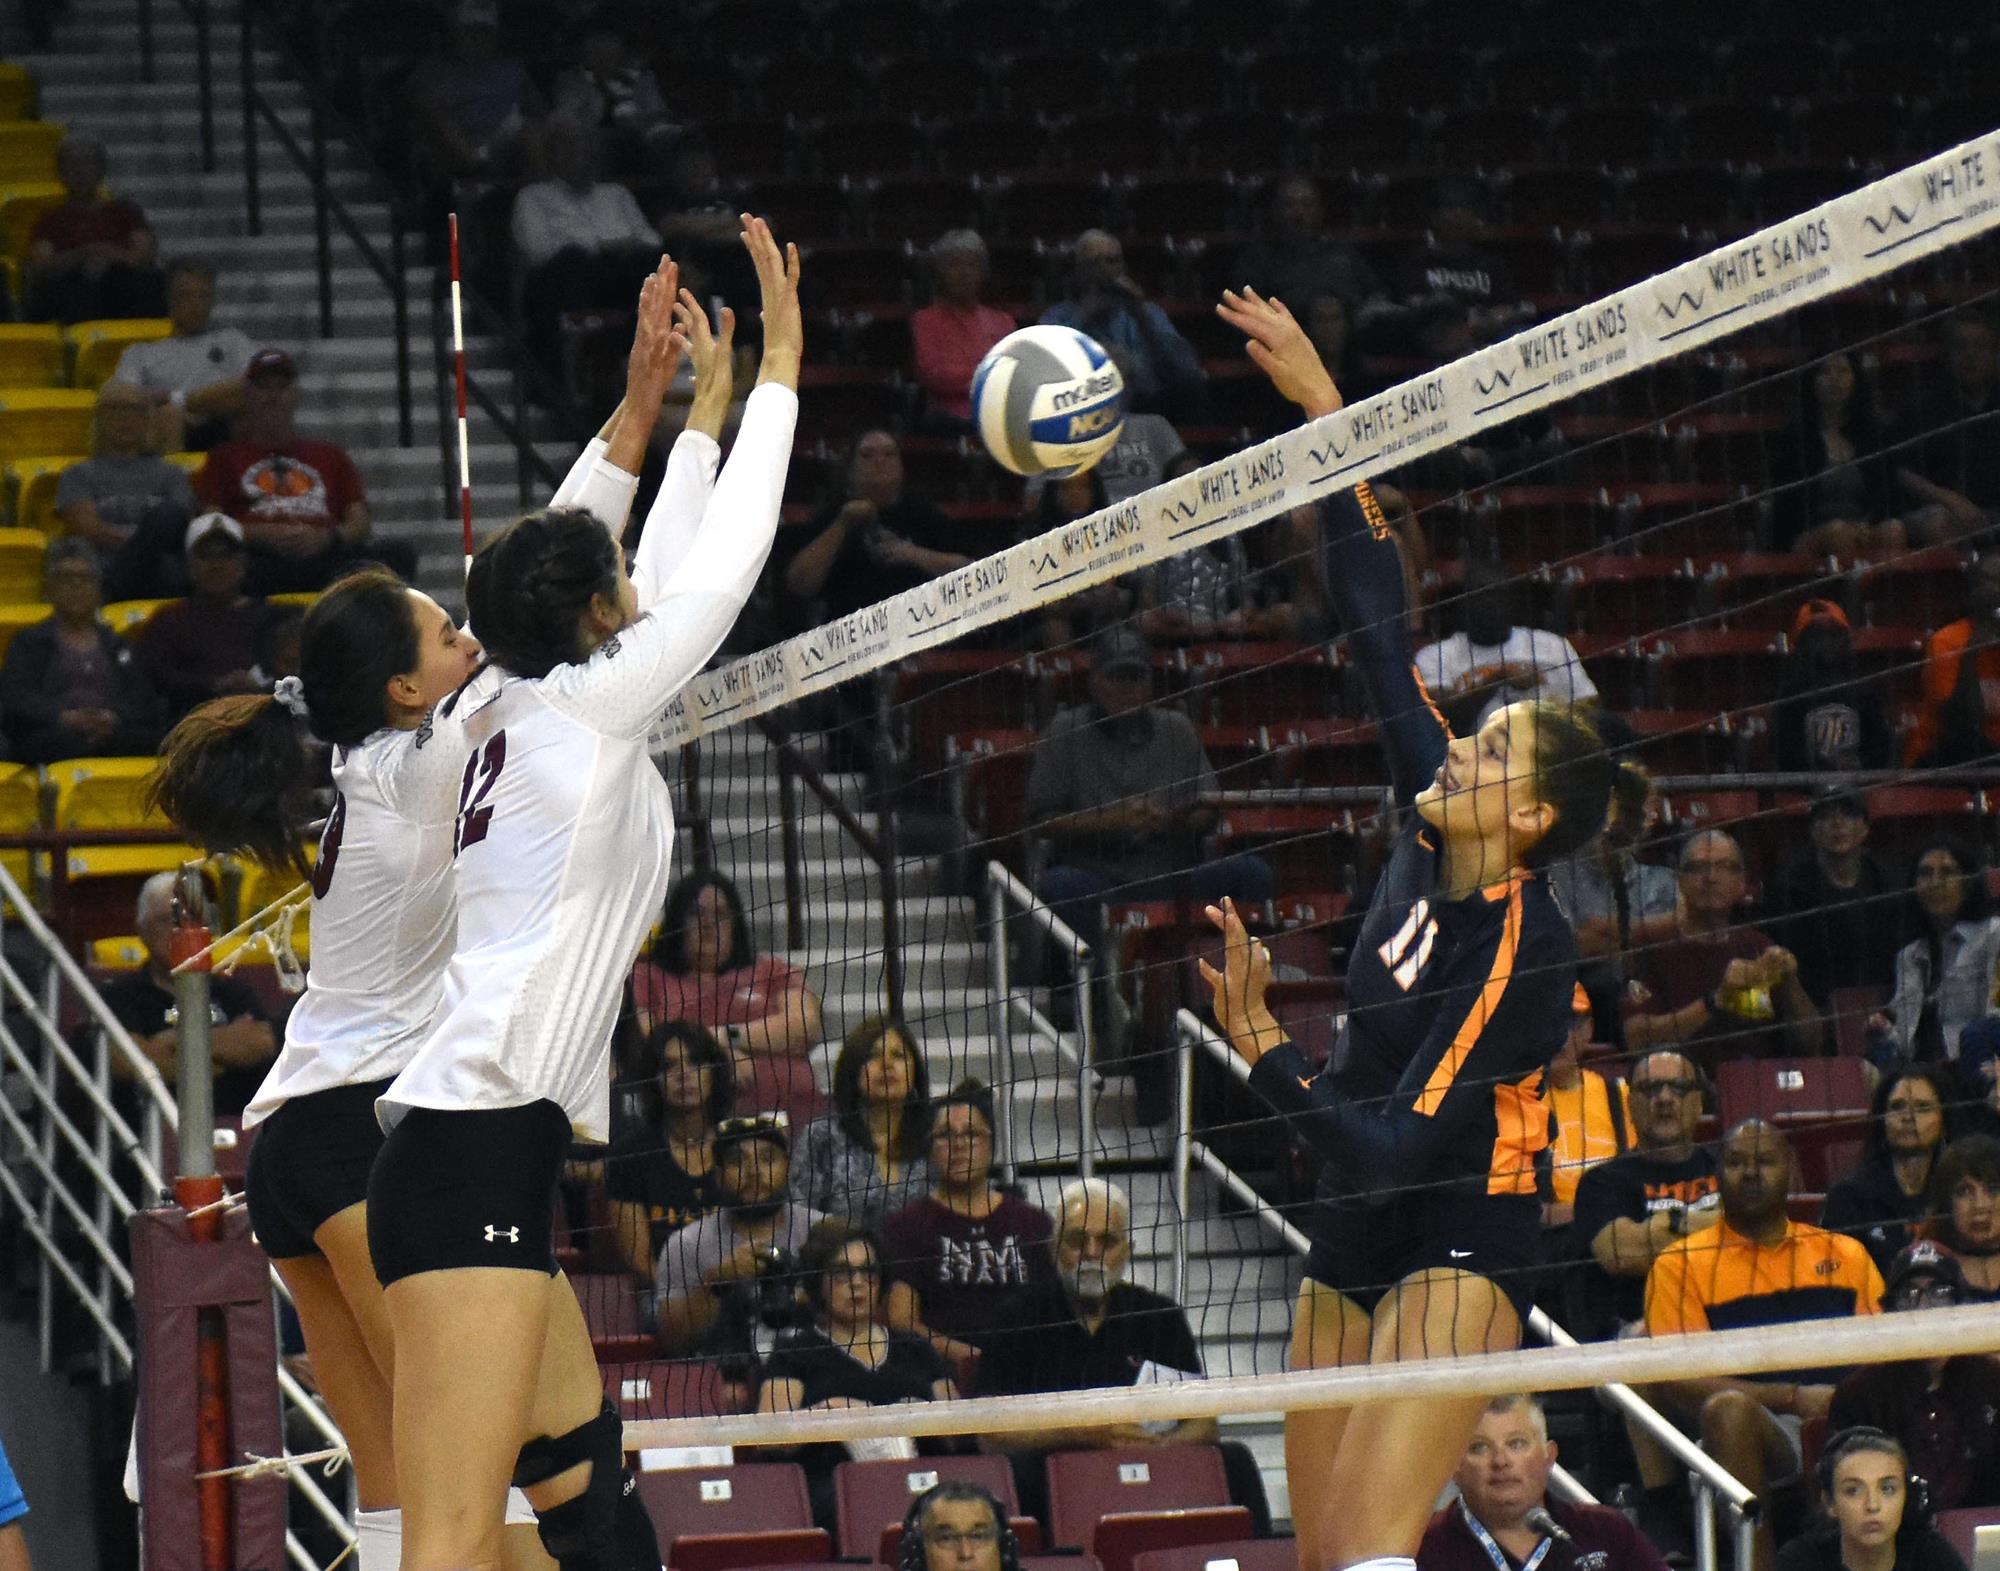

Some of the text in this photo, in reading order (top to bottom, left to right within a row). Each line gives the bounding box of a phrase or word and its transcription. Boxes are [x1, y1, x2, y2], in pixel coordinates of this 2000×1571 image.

[1922, 152, 1985, 202] WHITE
[1708, 217, 1830, 291] WHITE SANDS
[1519, 302, 1627, 369] WHITE SANDS
[1350, 377, 1446, 445] WHITE SANDS
[1200, 449, 1285, 505] WHITE SANDS
[1062, 504, 1142, 558] WHITE SANDS
[940, 572, 973, 607] WHITE
[975, 556, 1009, 593] SANDS
[826, 605, 890, 651] WHITE SANDS
[722, 663, 751, 695] WHITE
[755, 649, 785, 683] SANDS
[453, 728, 507, 861] 12
[1377, 897, 1440, 993] 11
[940, 1234, 1026, 1267] NM
